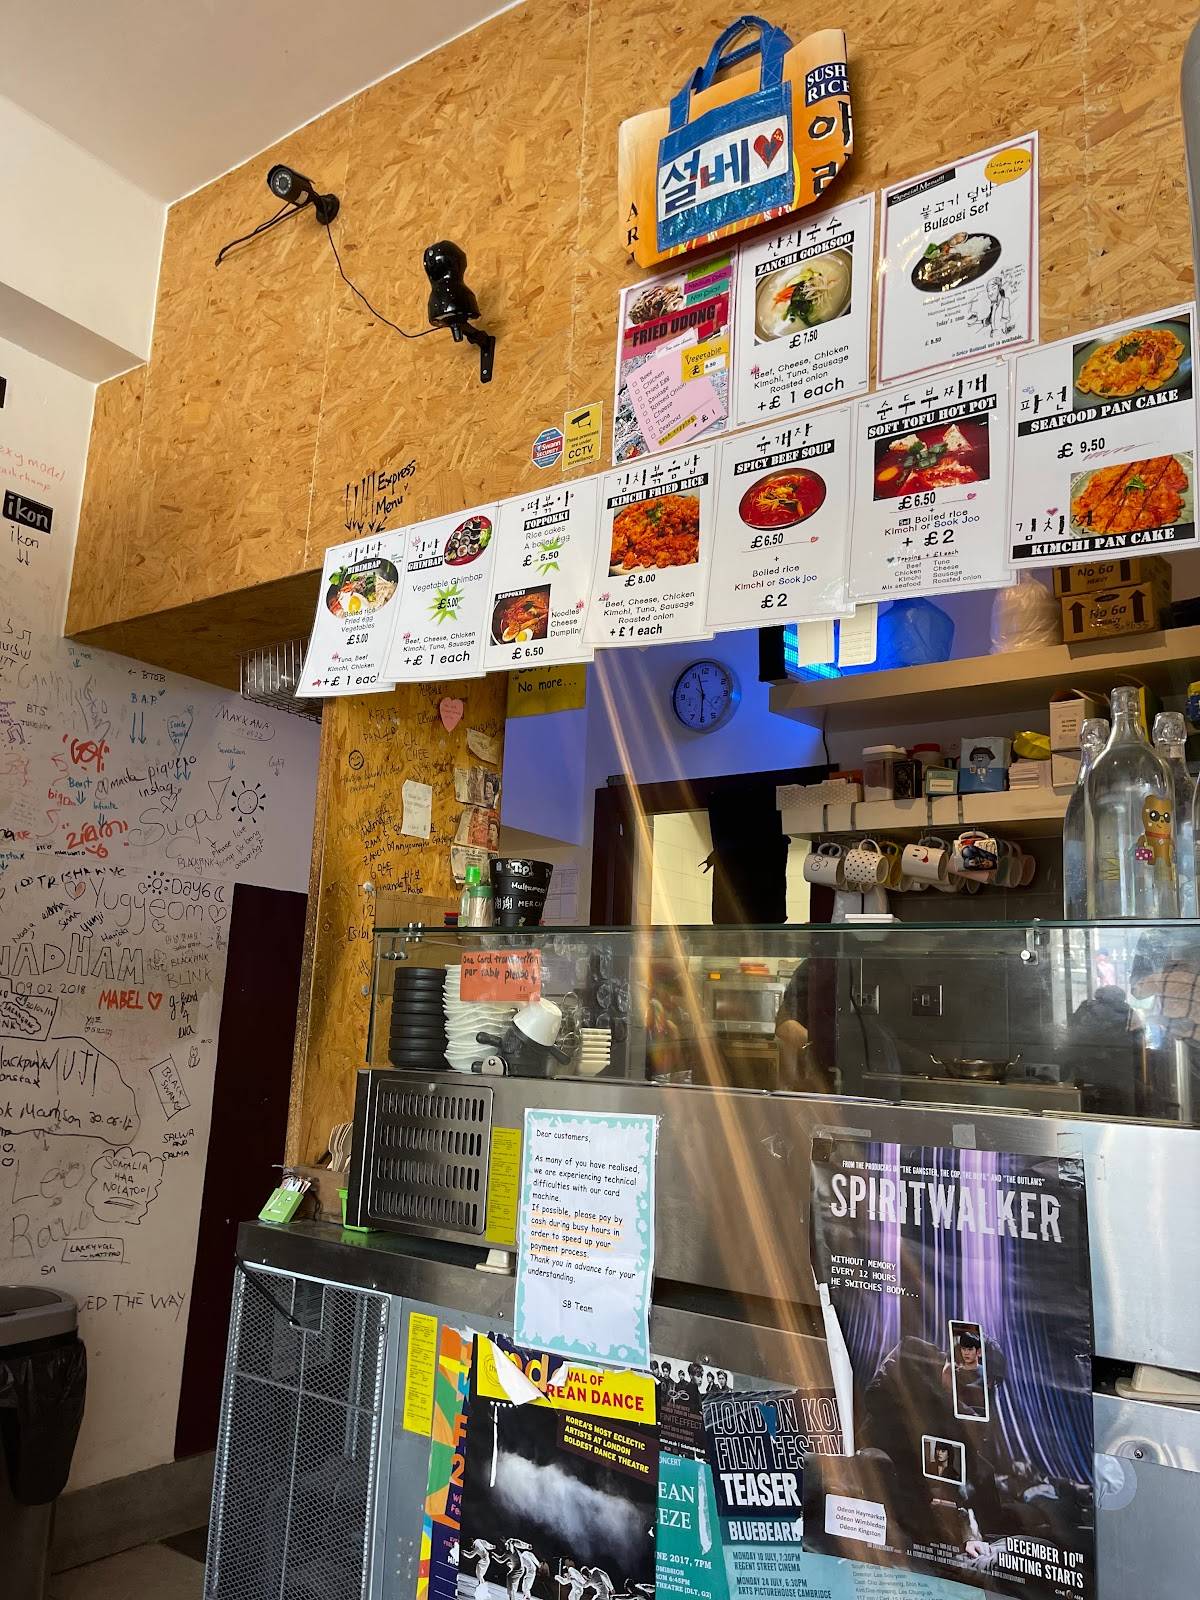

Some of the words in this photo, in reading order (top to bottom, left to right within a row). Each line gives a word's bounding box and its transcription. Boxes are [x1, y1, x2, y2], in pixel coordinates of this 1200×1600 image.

[807, 65, 847, 86] SUSH
[924, 209, 966, 232] Bulgogi
[970, 202, 989, 217] Set
[757, 254, 799, 275] ZANCHI
[800, 234, 851, 260] GOOKSOO
[632, 324, 668, 347] FRIED
[671, 304, 716, 333] UDONG
[804, 329, 818, 343] 7.50
[685, 346, 722, 364] Vegetable
[754, 370, 775, 380] Beef,
[778, 358, 811, 372] Cheese,
[814, 345, 849, 360] Chicken
[643, 371, 664, 389] Chicken
[754, 376, 784, 389] Kimchi,
[787, 369, 809, 380] Tuna,
[813, 355, 849, 370] Sausage
[770, 380, 803, 394] Roasted
[806, 370, 828, 382] onion
[804, 377, 844, 399] each
[654, 401, 673, 419] Cheese
[869, 422, 900, 439] SOFT
[902, 412, 935, 431] TOFU
[939, 404, 967, 420] HOT
[969, 396, 996, 412] POT
[1030, 408, 1097, 433] SEAFOOD
[1101, 400, 1132, 417] PAN
[1136, 389, 1178, 407] CAKE
[569, 444, 593, 459] CCTV
[1058, 443, 1073, 459] £
[1080, 437, 1105, 453] 9.50
[736, 458, 769, 474] SPICY
[771, 451, 799, 466] BEEF
[802, 442, 832, 458] SOUP
[377, 460, 417, 491] Express
[611, 489, 647, 507] KIMCHI
[649, 481, 679, 498] FRIED
[680, 475, 705, 489] RICE
[8, 496, 48, 529] ikon
[376, 496, 403, 516] Menu
[525, 511, 568, 530] TOPPOKKI
[915, 512, 946, 524] Boiled
[949, 509, 968, 519] rice
[11, 525, 39, 548] ikon
[525, 529, 542, 540] Rice
[544, 525, 566, 536] cakes
[1032, 539, 1090, 555] KIMCHI
[1094, 533, 1126, 548] PAN
[1131, 528, 1175, 543] CAKE
[348, 560, 381, 574] BIBIMBAP
[408, 556, 443, 571] GHIMBAP
[1078, 568, 1094, 577] No
[638, 574, 656, 584] 8.00
[440, 651, 470, 664] each
[525, 646, 544, 657] 6.50
[518, 681, 532, 693] No
[27, 704, 48, 716] BTS
[512, 861, 530, 876] Tip
[172, 878, 210, 900] Day6
[90, 877, 203, 935] Yugyeom
[61, 983, 86, 994] 2018
[98, 990, 144, 1010] MABEL
[162, 1129, 195, 1143] SALWA
[554, 1133, 590, 1142] customers,
[104, 1155, 149, 1173] SOMALIA
[162, 1150, 189, 1161] SALMA
[546, 1157, 562, 1166] many
[565, 1157, 572, 1165] of
[575, 1160, 587, 1168] you
[590, 1160, 605, 1169] have
[609, 1163, 640, 1174] realised,
[559, 1171, 601, 1183] experiencing
[604, 1175, 637, 1186] technical
[532, 1192, 561, 1202] machine.
[533, 1179, 569, 1190] difficulties
[573, 1184, 587, 1192] with
[604, 1188, 620, 1197] card
[542, 1206, 571, 1217] possible,
[575, 1209, 596, 1220] please
[614, 1214, 623, 1224] by
[831, 1174, 1062, 1243] SPIRITWALKER
[831, 1254, 864, 1266] WITHOUT
[868, 1260, 896, 1270] MEMORY
[831, 1266, 854, 1276] EVERY
[859, 1270, 868, 1279] 12
[872, 1272, 896, 1282] HOURS
[845, 1279, 882, 1292] SWITCHES
[887, 1285, 919, 1298] BODY...
[114, 1292, 145, 1311] THE
[151, 1291, 186, 1321] WAY
[562, 1300, 572, 1308] SB
[575, 1302, 593, 1313] Team
[590, 1375, 604, 1386] OF
[591, 1390, 644, 1411] DANCE
[565, 1415, 593, 1431] KOREA'S
[594, 1426, 613, 1438] MOST
[613, 1433, 646, 1451] ECLECTIC
[565, 1426, 592, 1440] ARTISTS
[593, 1436, 602, 1445] AT
[603, 1439, 631, 1456] LONDON
[564, 1435, 593, 1451] BOLDEST
[594, 1447, 617, 1461] DANCE
[618, 1455, 650, 1474] THEATRE
[715, 1436, 768, 1471] FILM
[720, 1473, 802, 1506] TEASER
[835, 1514, 854, 1524] Odeon
[857, 1526, 882, 1538] Kingston
[1006, 1537, 1059, 1563] DECEMBER
[670, 1554, 693, 1567] 2017,
[694, 1559, 712, 1569] 7PM
[735, 1562, 756, 1571] REGENT
[757, 1562, 777, 1571] STREET
[778, 1562, 800, 1572] CINEMA
[998, 1552, 1043, 1579] HUNTING
[1045, 1564, 1084, 1589] STARTS
